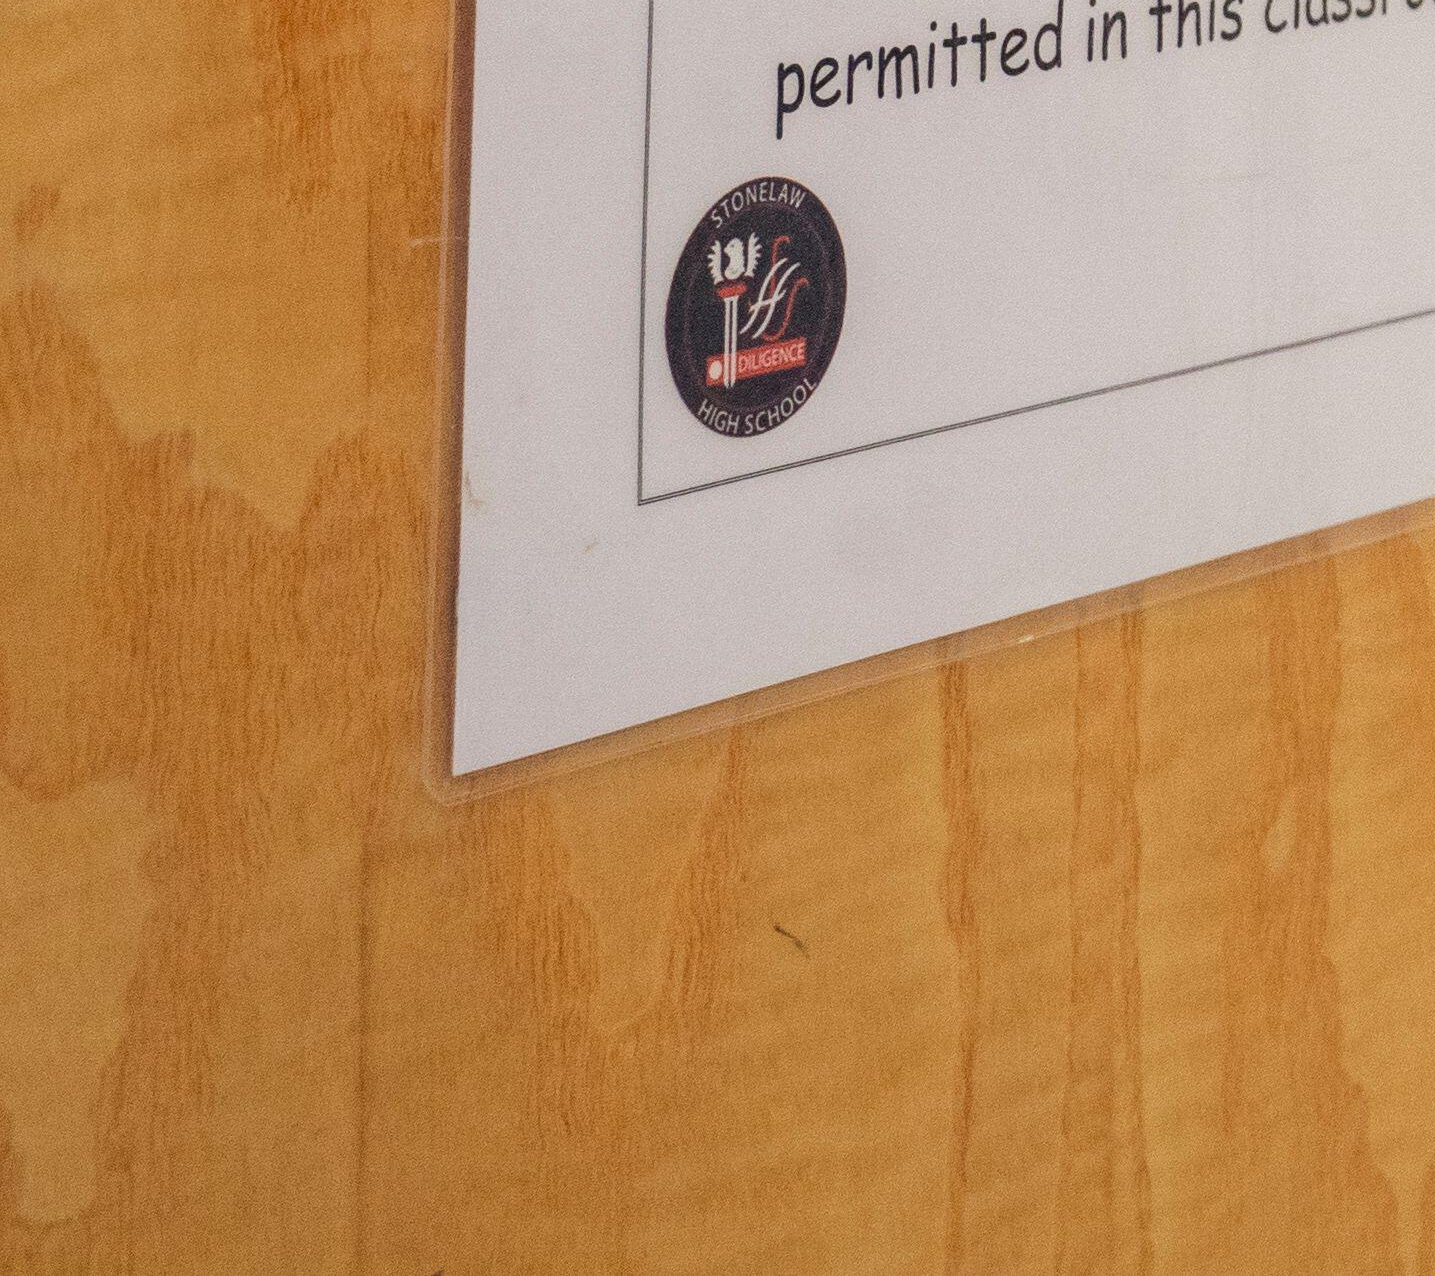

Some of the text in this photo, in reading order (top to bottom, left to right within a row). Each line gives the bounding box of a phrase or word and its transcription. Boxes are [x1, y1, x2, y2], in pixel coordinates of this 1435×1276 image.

[710, 181, 807, 229] STONELAW
[737, 342, 805, 373] DILIGENCE
[697, 377, 819, 436] HIGH SCHOOL
